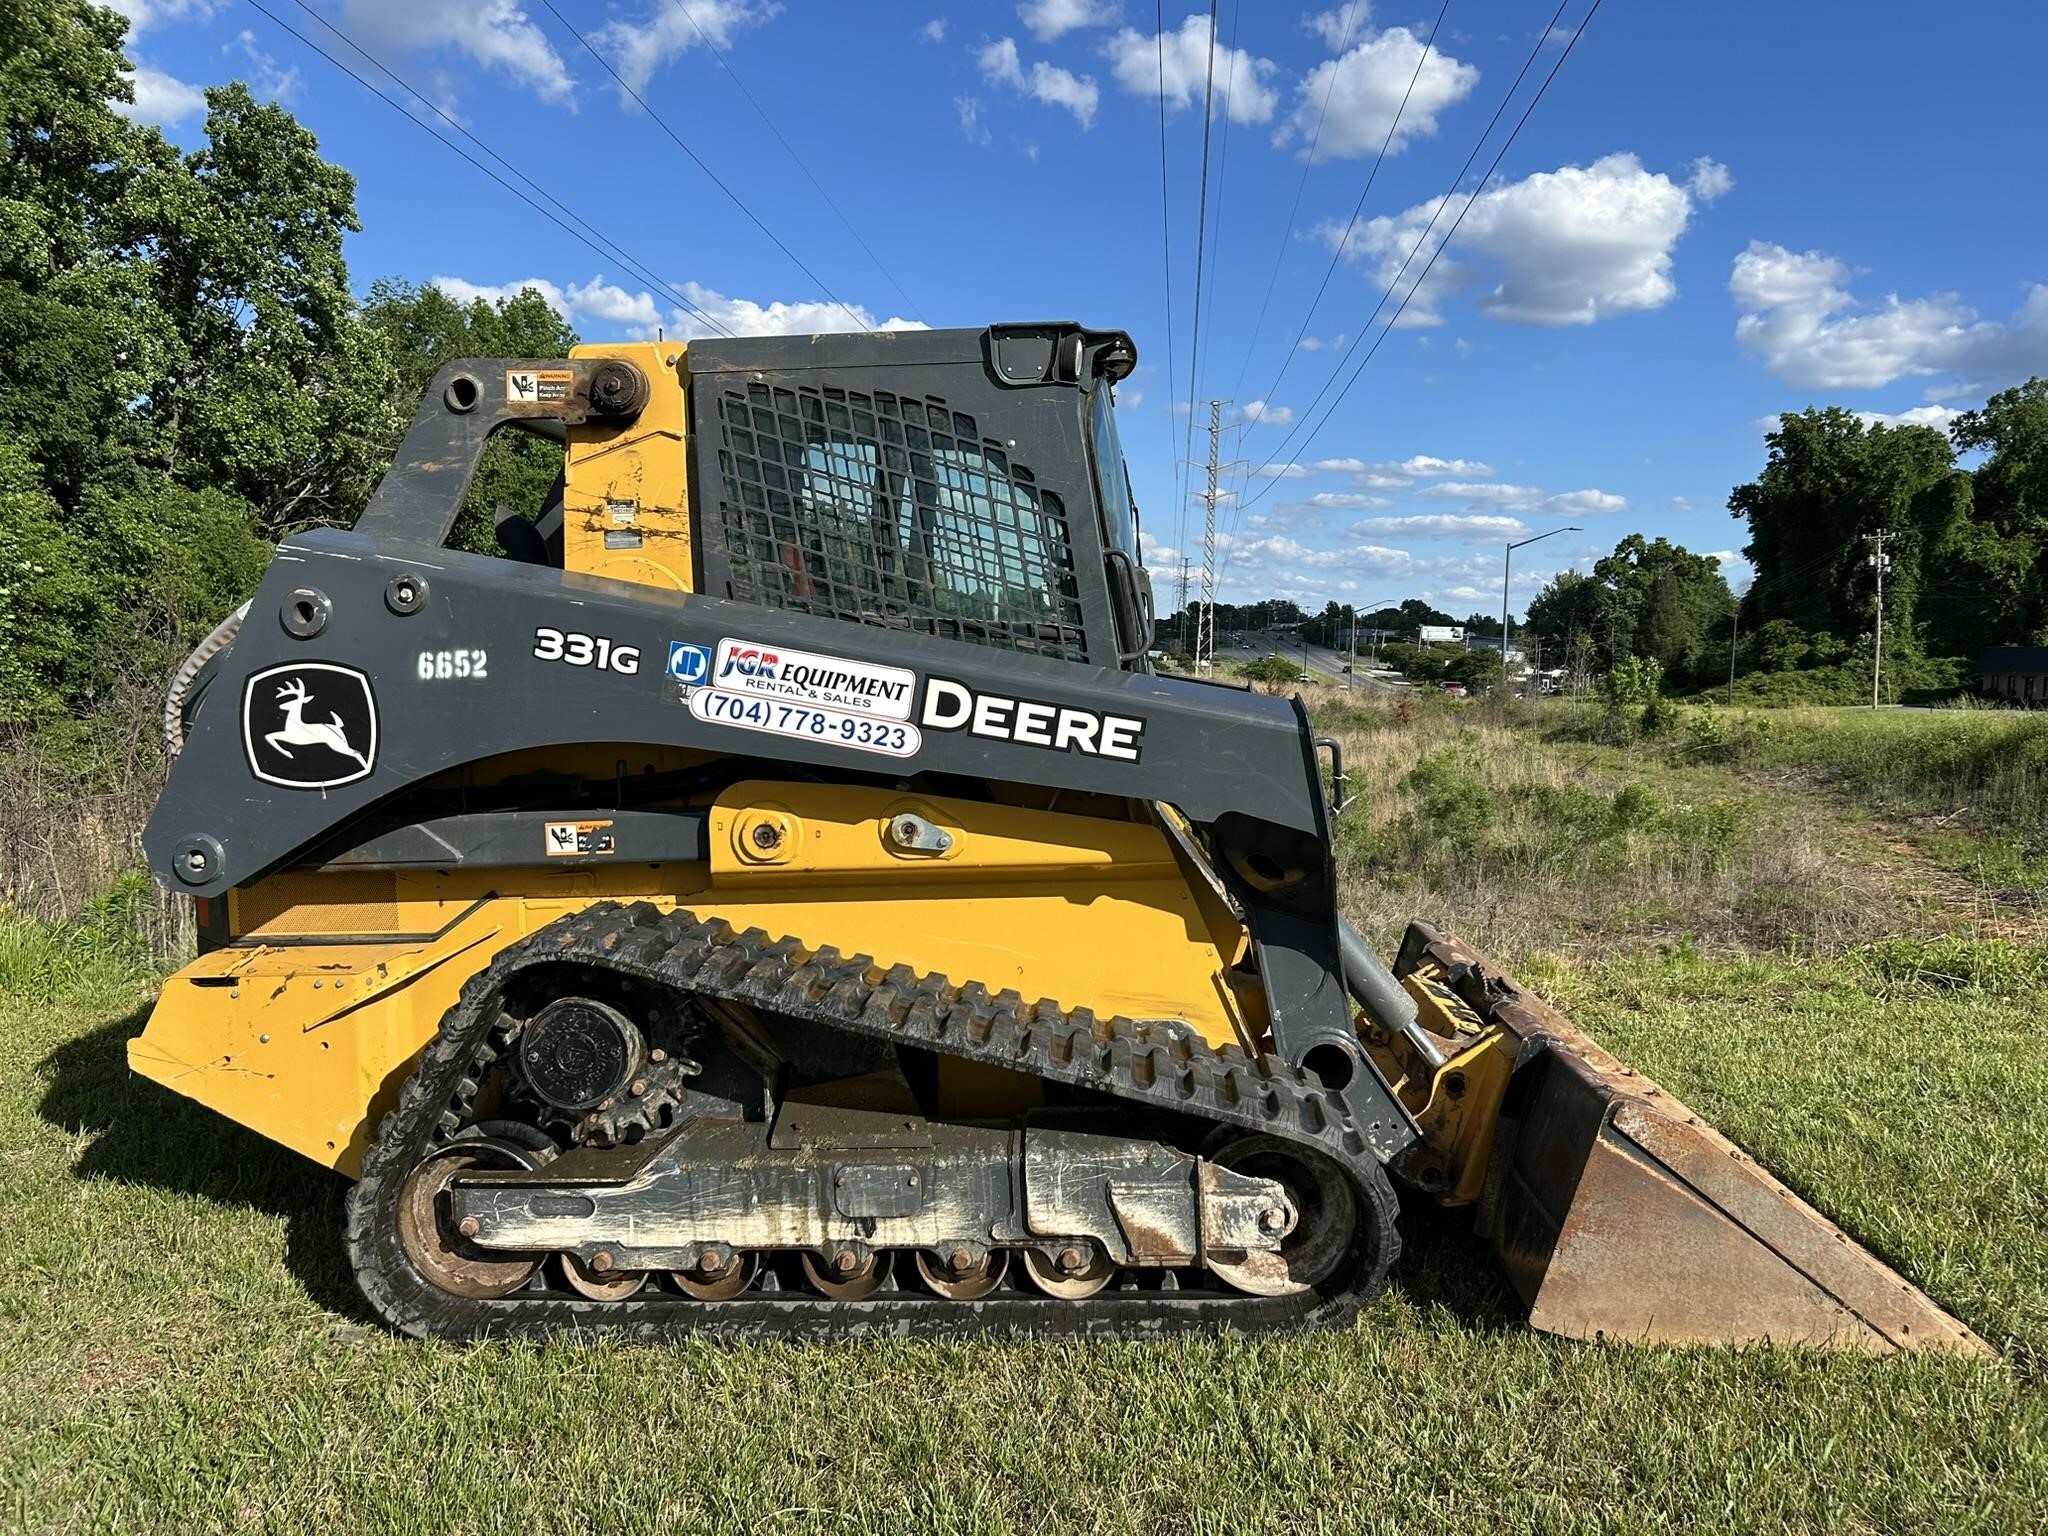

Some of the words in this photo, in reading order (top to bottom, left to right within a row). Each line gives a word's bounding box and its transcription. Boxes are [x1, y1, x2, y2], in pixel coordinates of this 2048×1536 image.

[418, 649, 488, 679] 6652
[533, 627, 641, 675] 331G
[719, 646, 779, 679] JGR
[780, 664, 909, 701] EQUIPMENT
[746, 678, 804, 696] RENTAL
[808, 689, 818, 699] &
[822, 692, 872, 708] SALES
[704, 692, 771, 727] (704)
[778, 706, 906, 749] 778-9323
[921, 677, 1143, 761] DEERE
